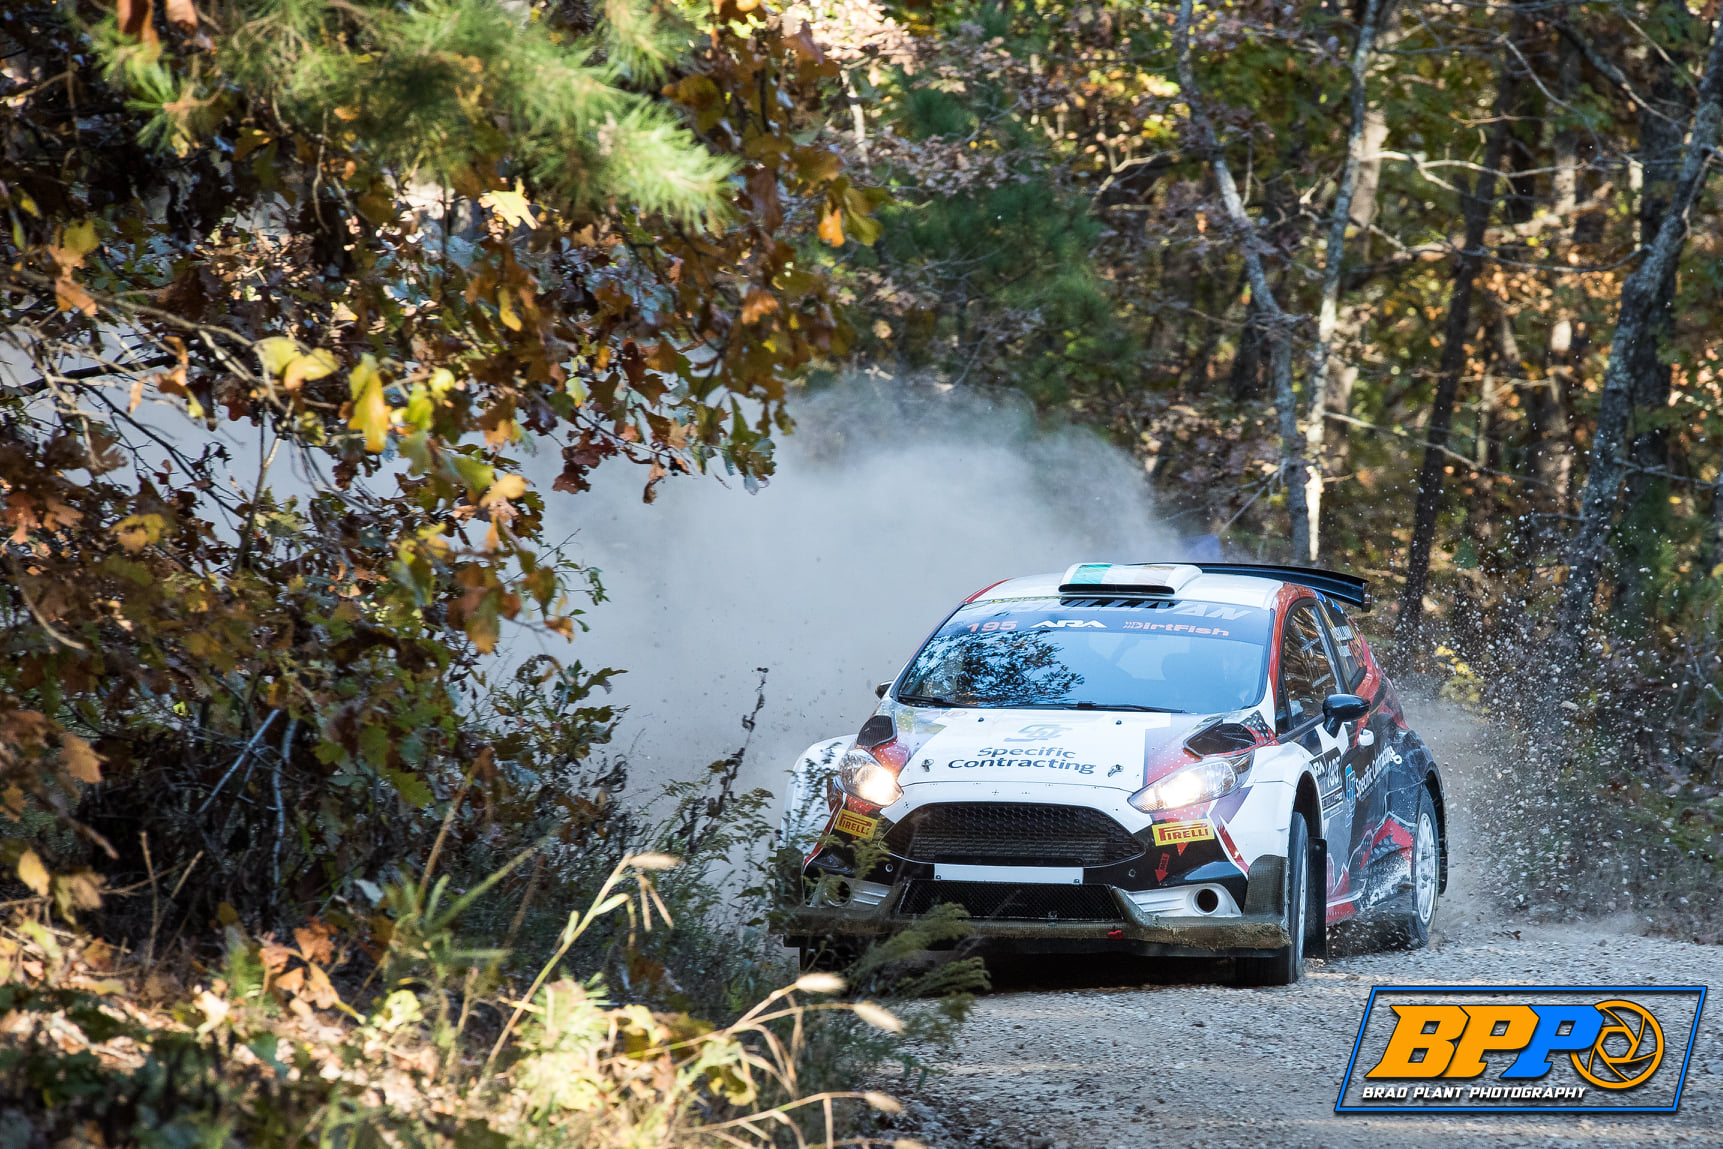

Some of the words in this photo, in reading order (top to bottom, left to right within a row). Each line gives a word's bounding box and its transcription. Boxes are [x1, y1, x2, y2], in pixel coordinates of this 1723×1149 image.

[966, 620, 1018, 633] 195
[1030, 619, 1107, 628] ARA
[1122, 621, 1229, 636] DirtFish
[977, 746, 1076, 758] Specific
[948, 757, 1096, 775] Contracting
[1158, 822, 1209, 842] PIRELLI
